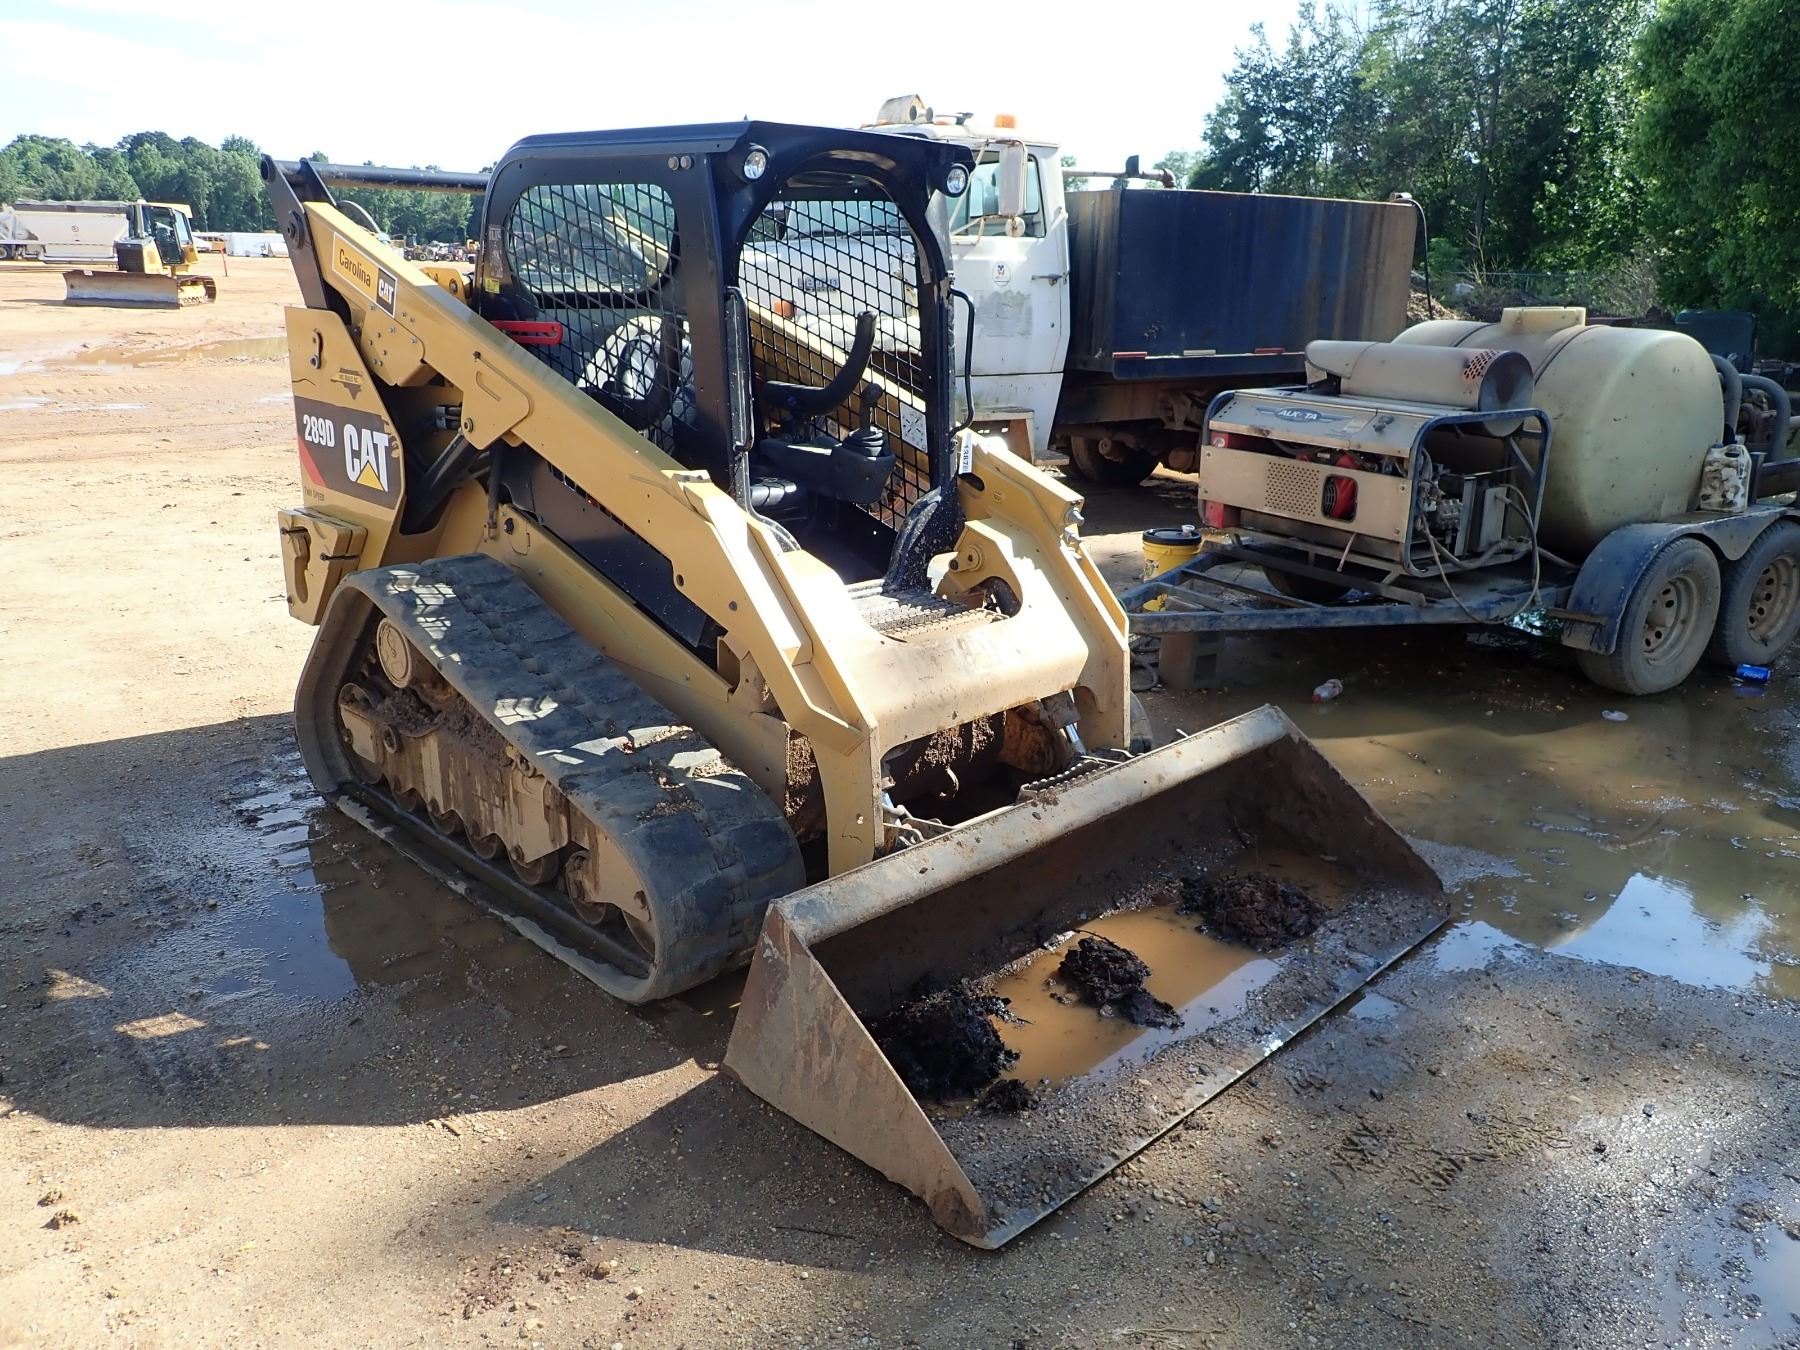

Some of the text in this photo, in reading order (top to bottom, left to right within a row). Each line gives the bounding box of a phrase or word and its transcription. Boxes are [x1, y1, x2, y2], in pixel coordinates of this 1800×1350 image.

[339, 248, 394, 305] Carolina CAT
[303, 414, 335, 448] 289D
[1278, 409, 1318, 420] ALKTA
[343, 423, 389, 492] CAT
